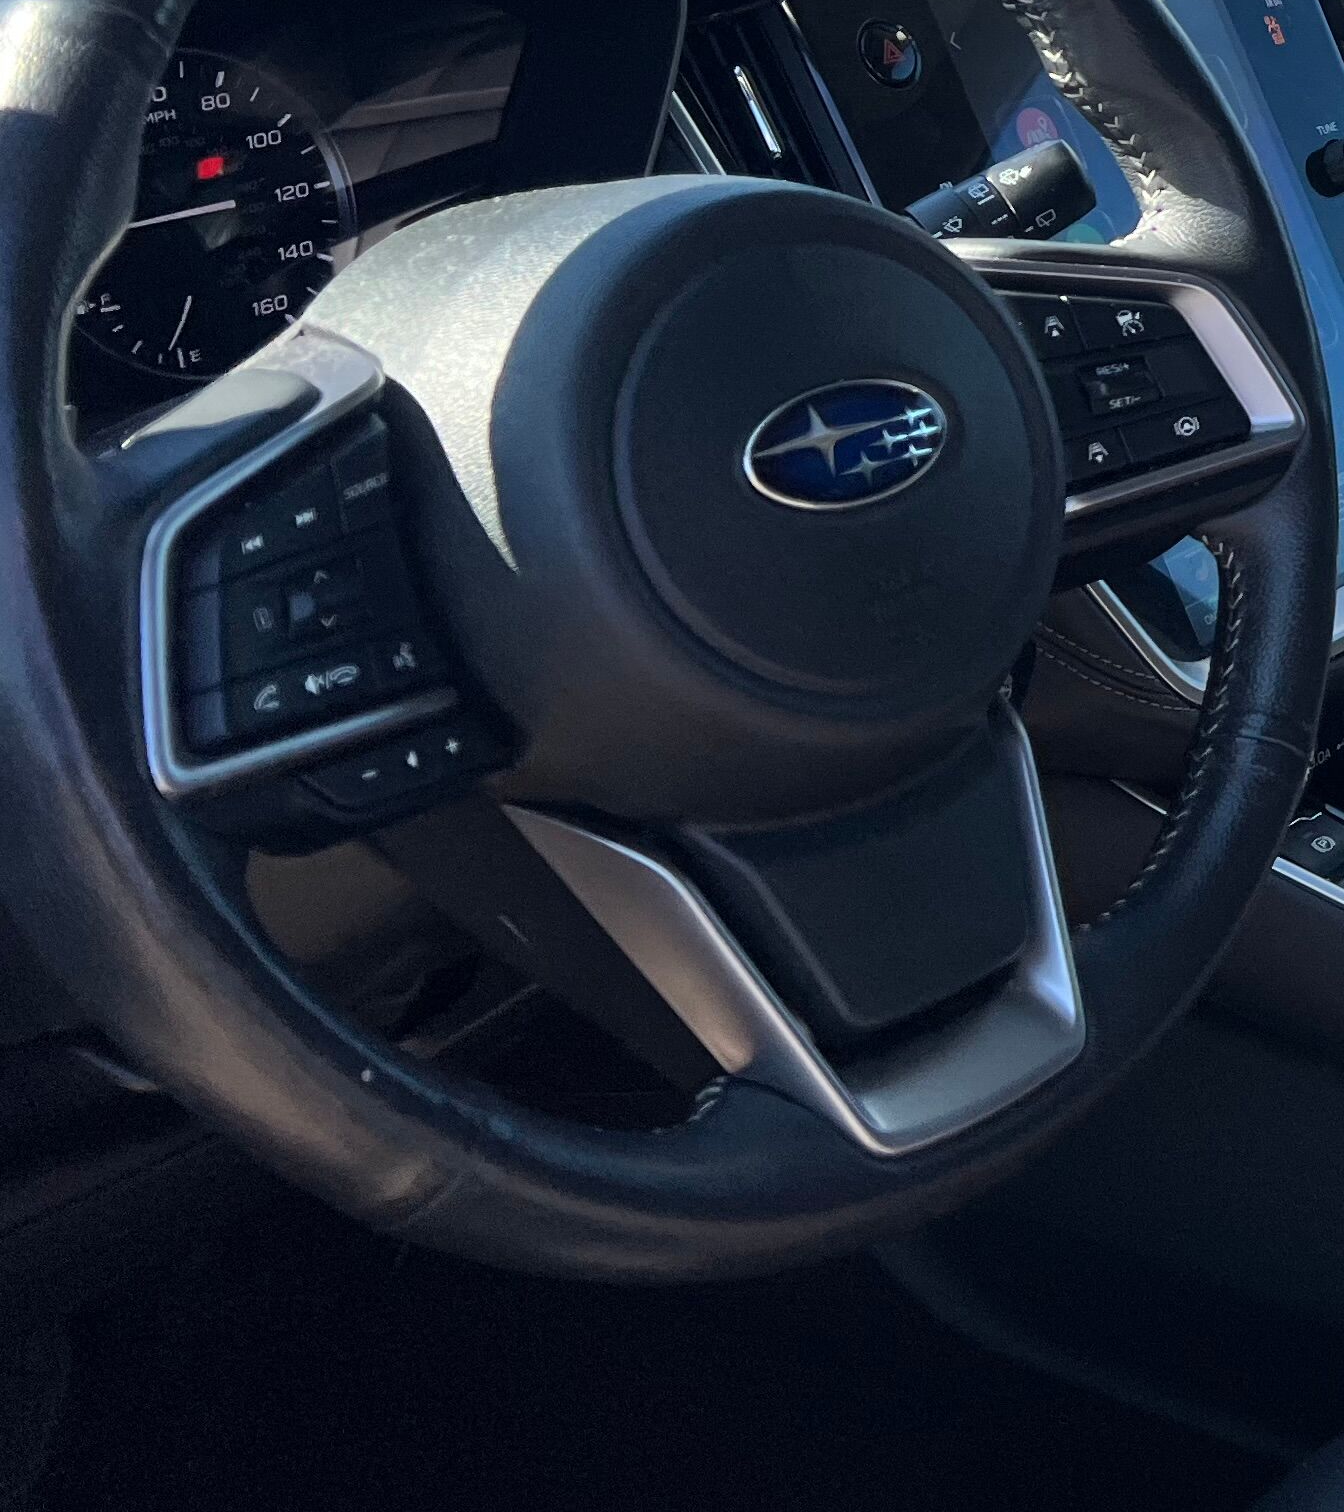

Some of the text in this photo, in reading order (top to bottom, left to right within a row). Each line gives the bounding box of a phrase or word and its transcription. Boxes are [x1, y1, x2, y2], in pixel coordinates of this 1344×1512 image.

[201, 92, 231, 111] 80
[1315, 121, 1339, 136] TUNE
[245, 129, 282, 149] 100
[274, 182, 310, 203] 120
[278, 240, 314, 261] 140
[252, 294, 288, 316] 160
[190, 349, 201, 363] E
